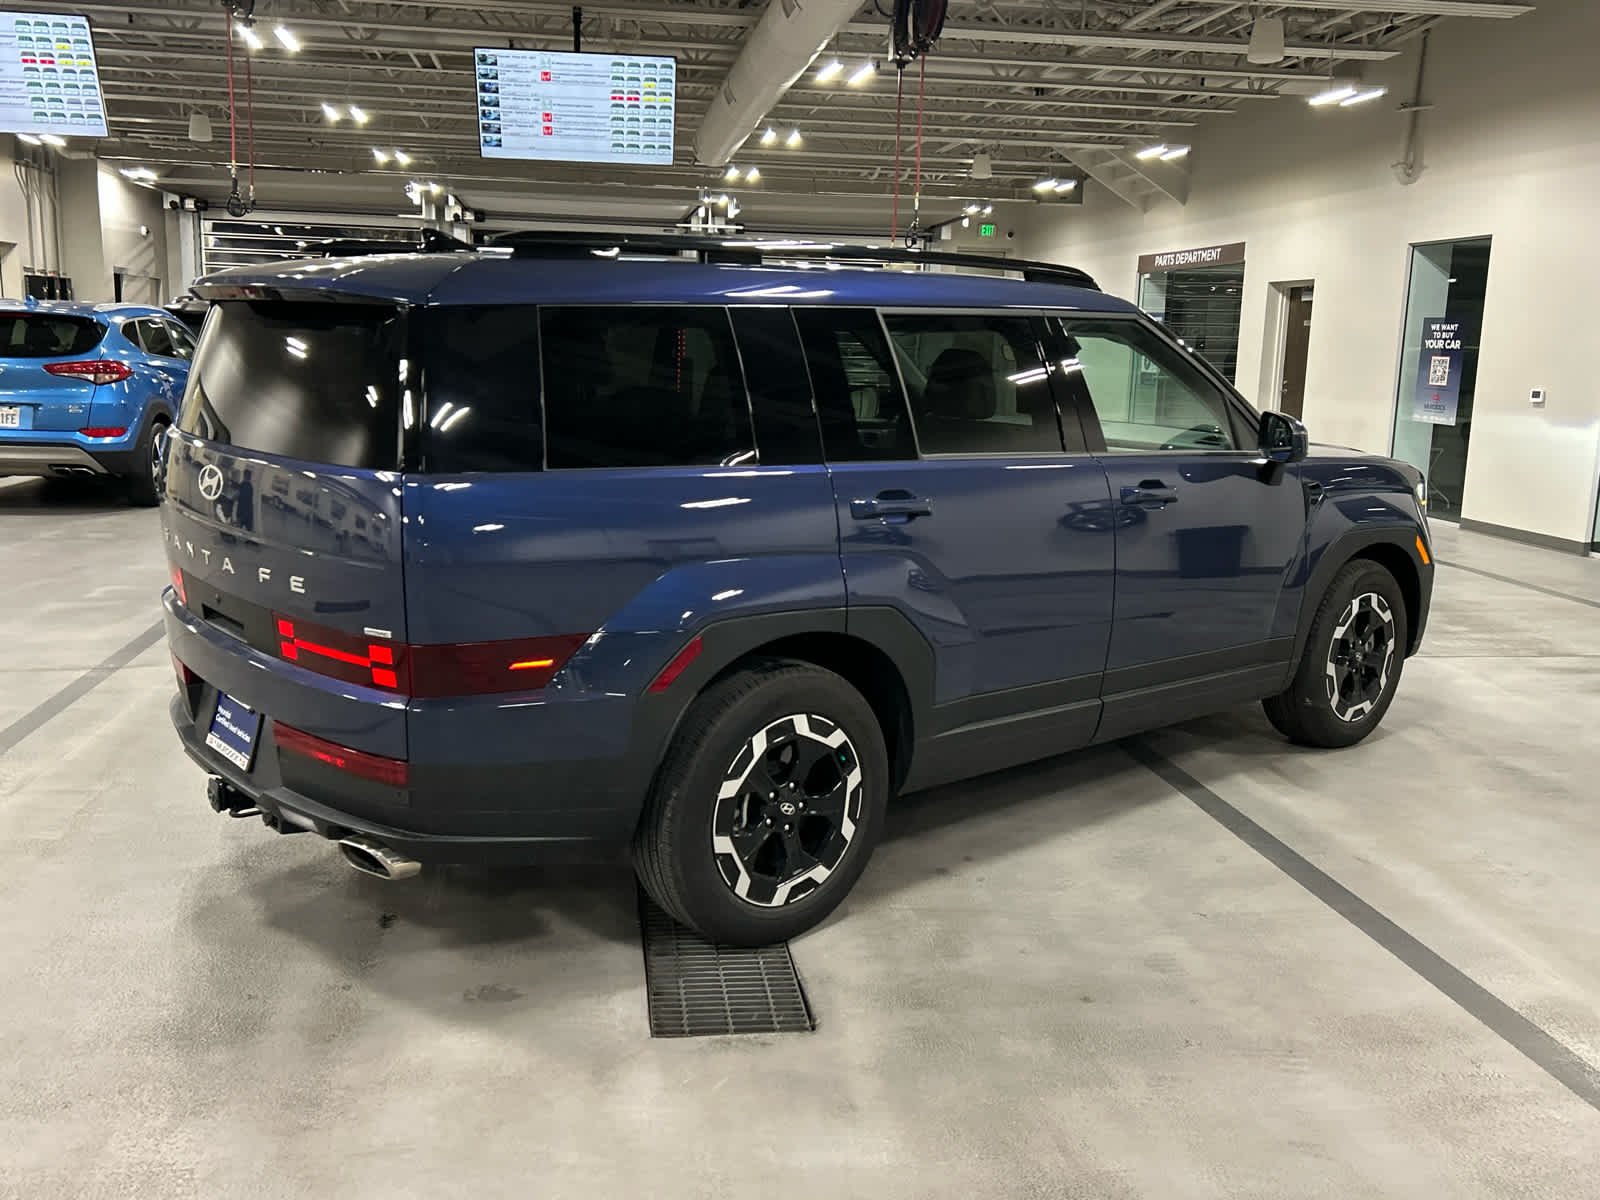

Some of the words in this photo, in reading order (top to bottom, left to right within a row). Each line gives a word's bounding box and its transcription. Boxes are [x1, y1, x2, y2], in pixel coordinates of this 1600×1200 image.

[981, 224, 995, 236] EXIT
[1154, 254, 1175, 267] PARTS
[1175, 248, 1221, 265] DEPARTMENT
[1424, 340, 1444, 349] YOUR
[1444, 340, 1461, 350] CAR
